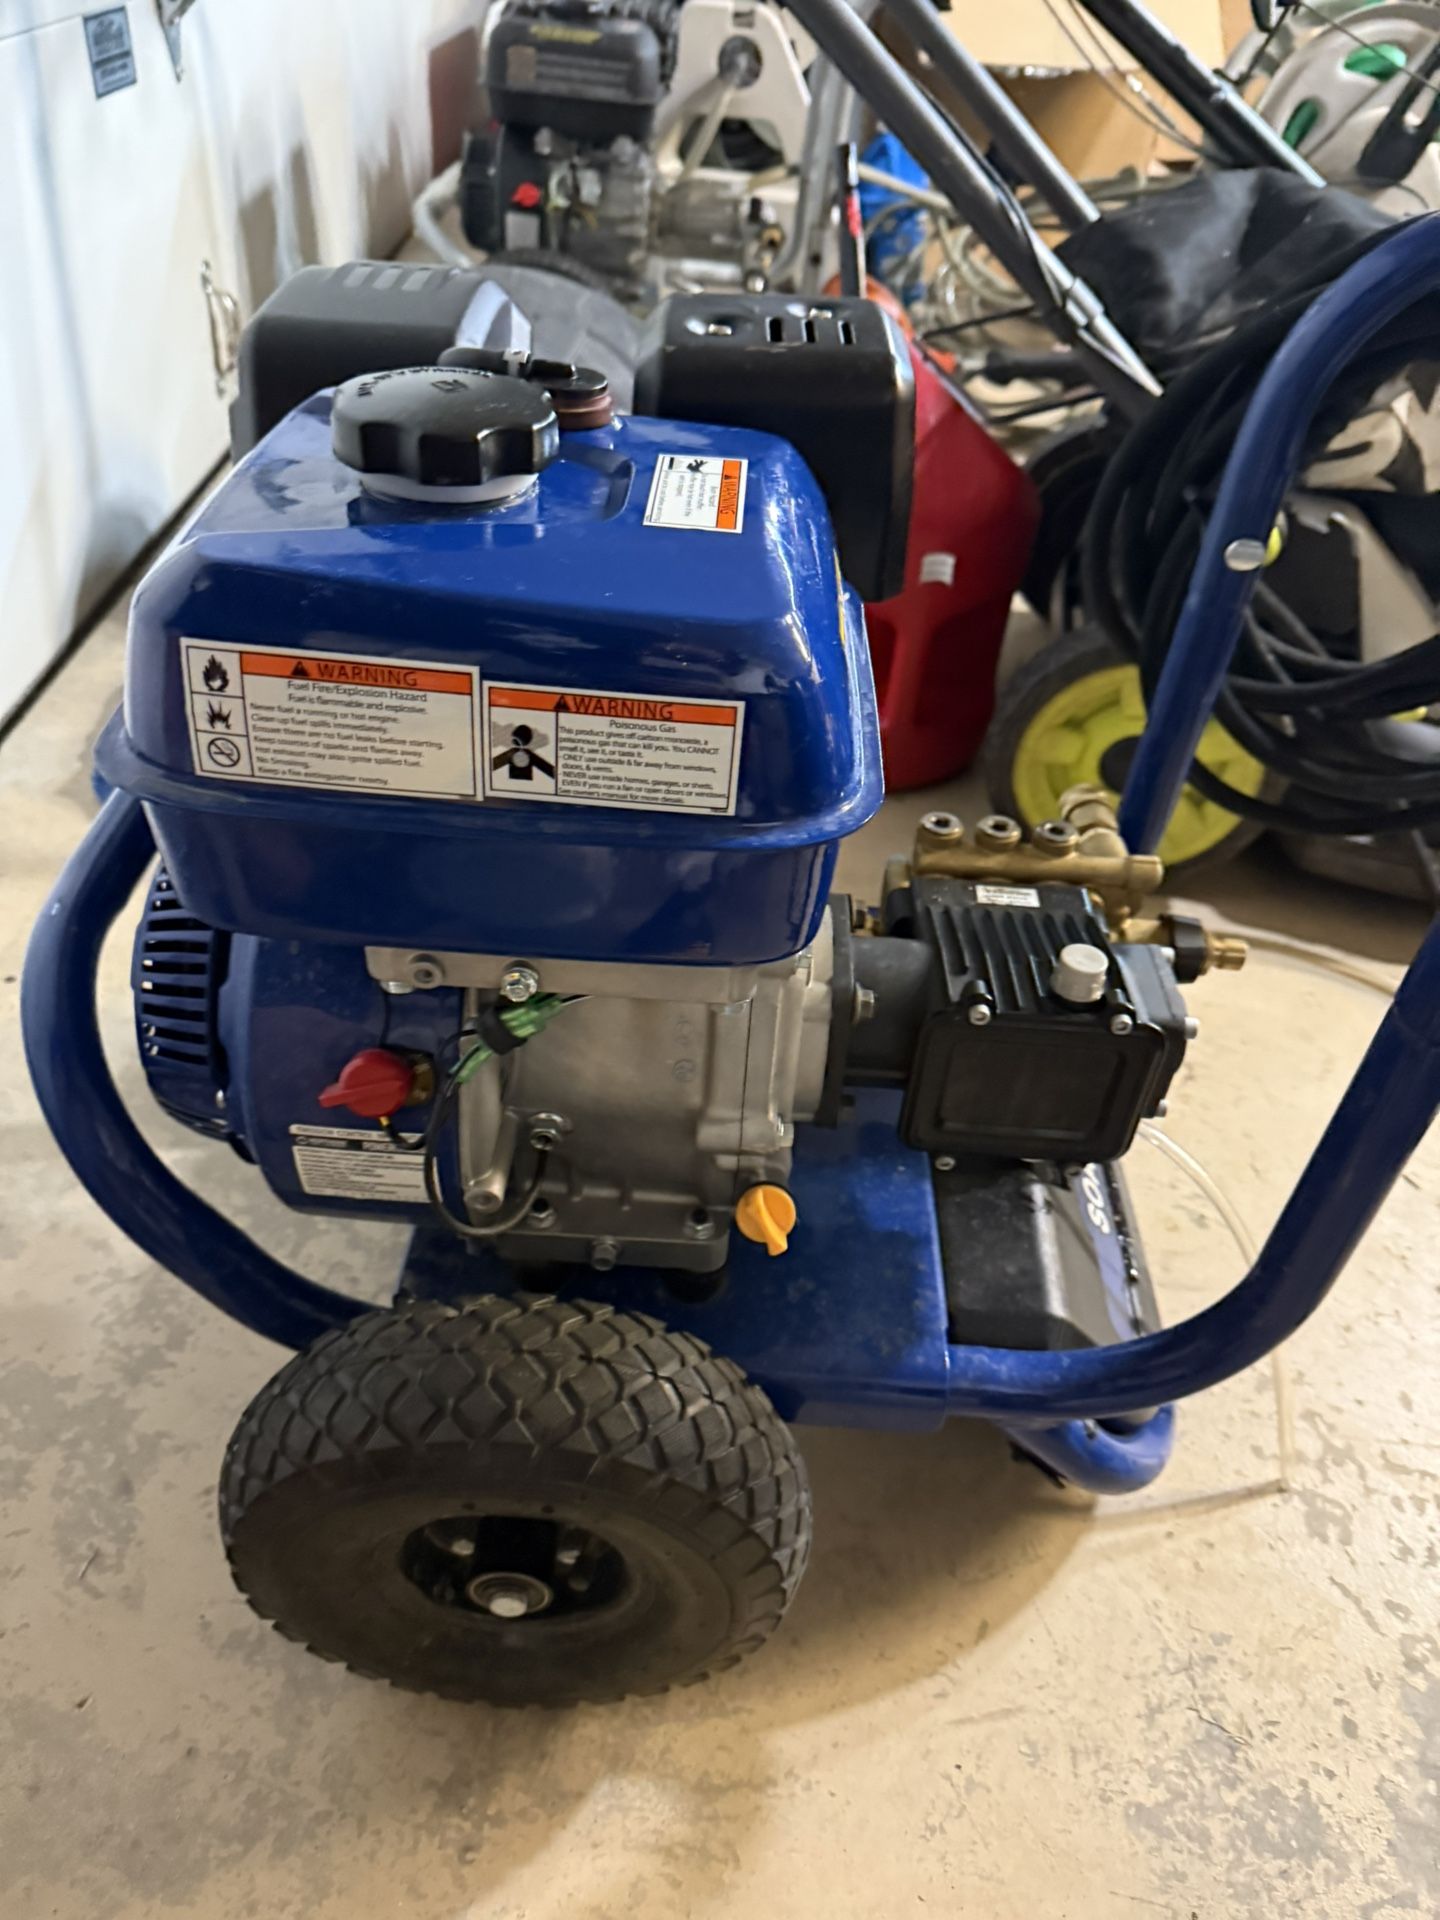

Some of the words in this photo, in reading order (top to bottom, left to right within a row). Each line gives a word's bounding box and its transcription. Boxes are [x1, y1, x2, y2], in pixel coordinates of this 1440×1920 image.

[720, 481, 738, 515] WARNING
[316, 662, 416, 686] WARNING
[287, 680, 309, 690] Fuel
[311, 682, 387, 700] Fire/Explosion
[389, 690, 426, 702] Hazard
[288, 693, 306, 702] Fuel
[316, 695, 364, 707] flammable
[365, 700, 383, 709] and
[573, 696, 673, 720] WARNING
[250, 703, 275, 711] Never
[303, 708, 337, 719] running
[252, 724, 281, 733] Ensure
[283, 727, 306, 736] there
[355, 734, 376, 742] leaks
[378, 736, 406, 745] before
[575, 728, 604, 737] product
[605, 731, 624, 740] gives
[637, 732, 662, 740] carbon
[609, 719, 656, 731] Poisonous
[658, 723, 676, 733] Gas
[254, 736, 276, 744] Keep
[277, 738, 309, 747] sources
[370, 746, 398, 755] flames
[559, 736, 596, 745] poisonous
[687, 745, 720, 755] CANNOT
[307, 751, 325, 759] may
[598, 756, 624, 764] outside
[644, 761, 662, 769] away
[258, 766, 279, 775] Keep
